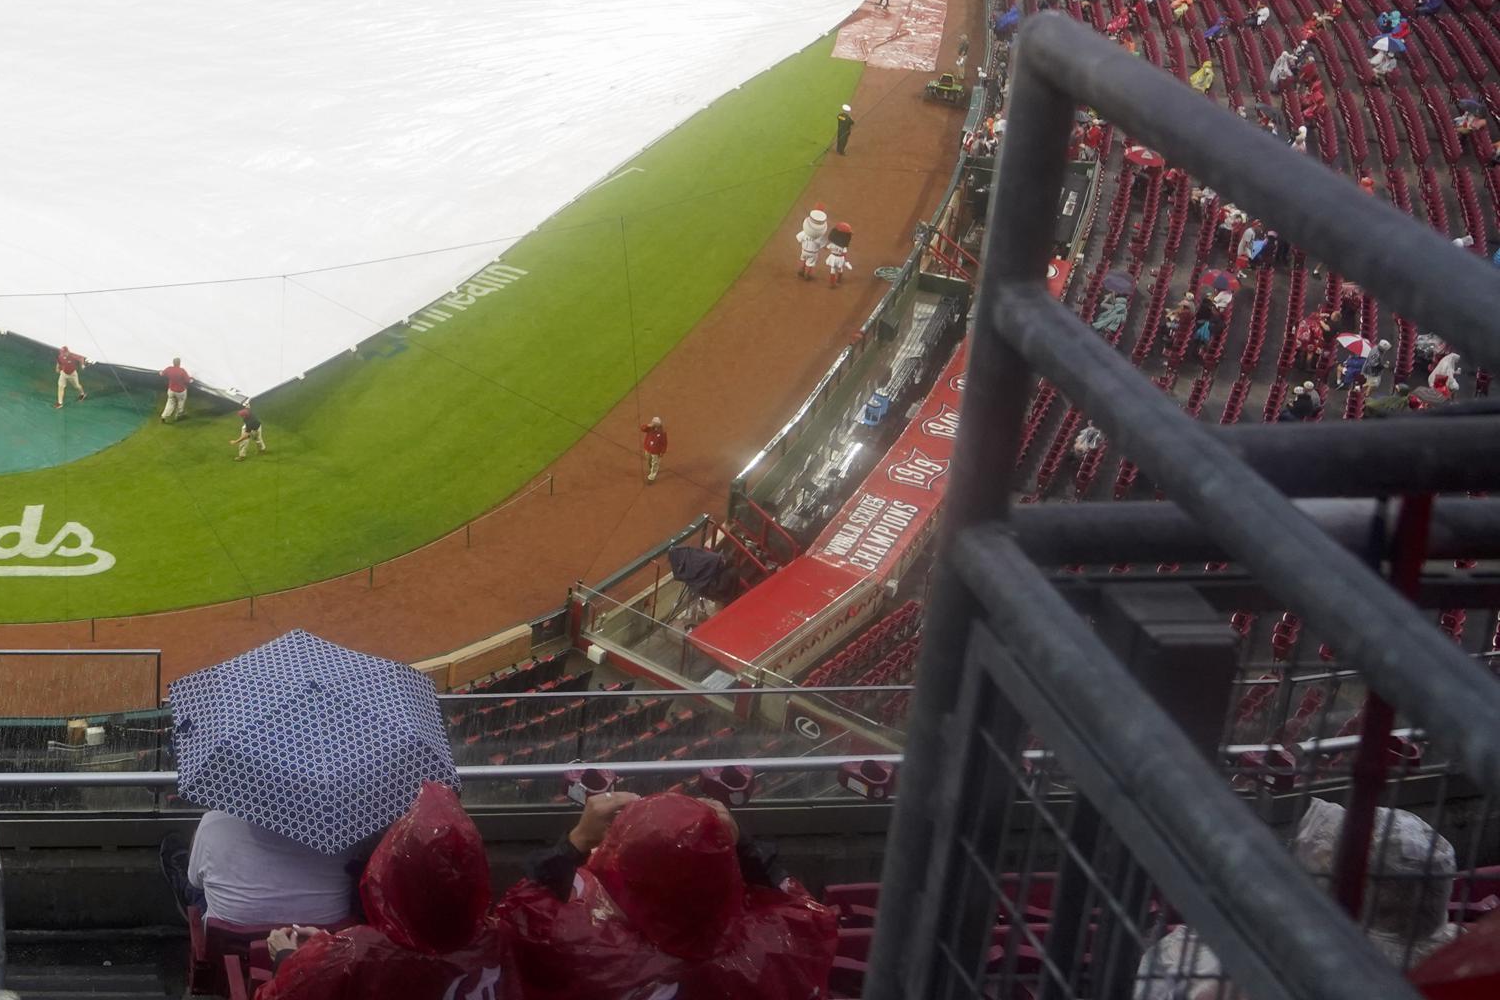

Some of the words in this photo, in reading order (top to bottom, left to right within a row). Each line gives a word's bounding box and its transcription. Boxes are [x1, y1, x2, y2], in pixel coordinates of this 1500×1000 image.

[895, 458, 943, 486] 1919
[823, 522, 864, 556] WORLD
[849, 493, 887, 526] SERIES
[850, 499, 919, 571] CHAMPIONS
